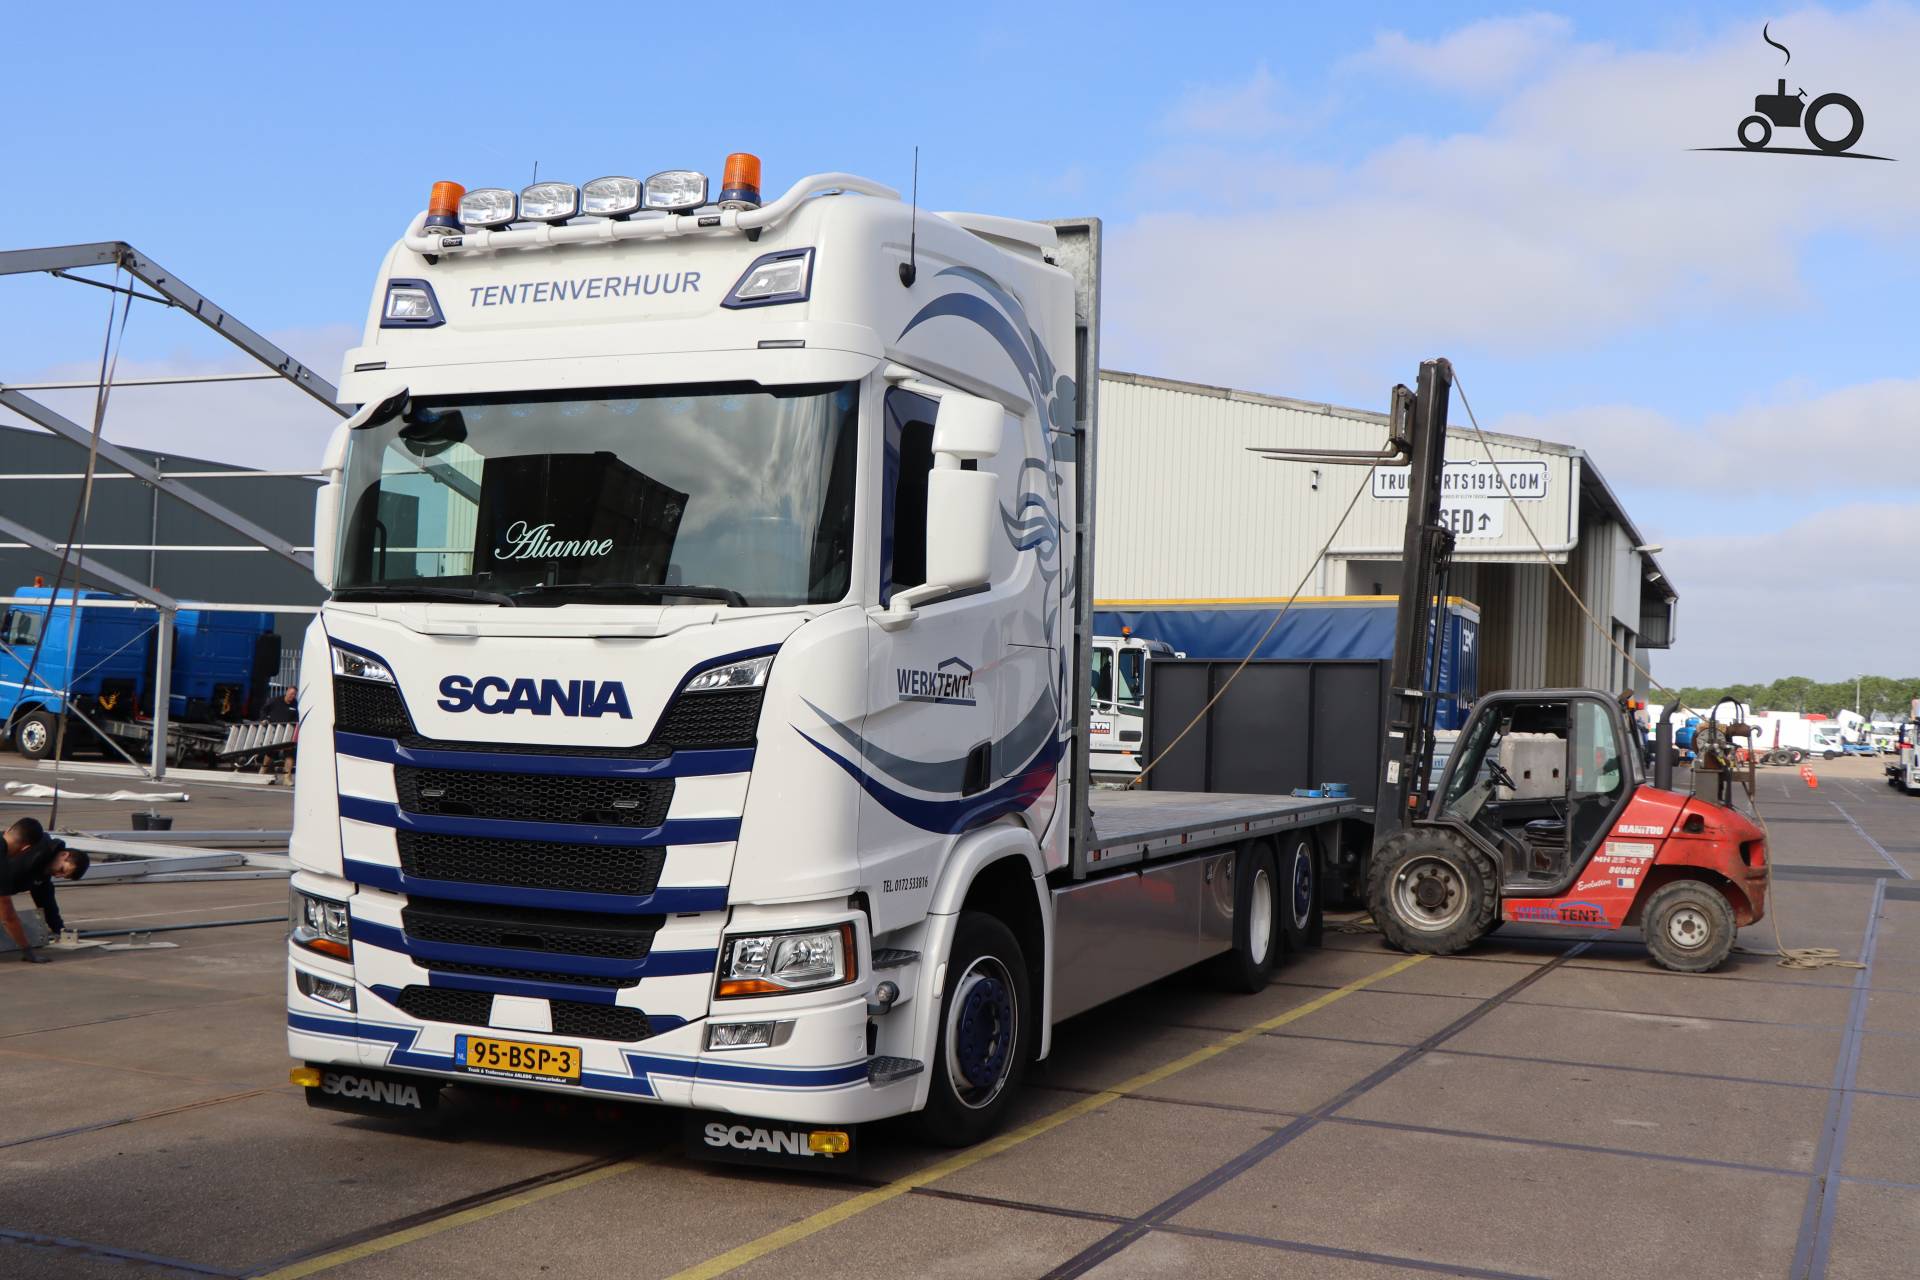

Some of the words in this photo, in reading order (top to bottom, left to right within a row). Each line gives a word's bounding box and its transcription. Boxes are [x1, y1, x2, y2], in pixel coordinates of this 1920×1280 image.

[470, 271, 701, 307] TENTENVERHUUR
[494, 520, 614, 560] Alianne
[437, 675, 633, 720] SCANIA
[474, 1042, 571, 1073] 95-BSP-3
[321, 1072, 421, 1108] SCANIA
[704, 1123, 834, 1158] SCANI
